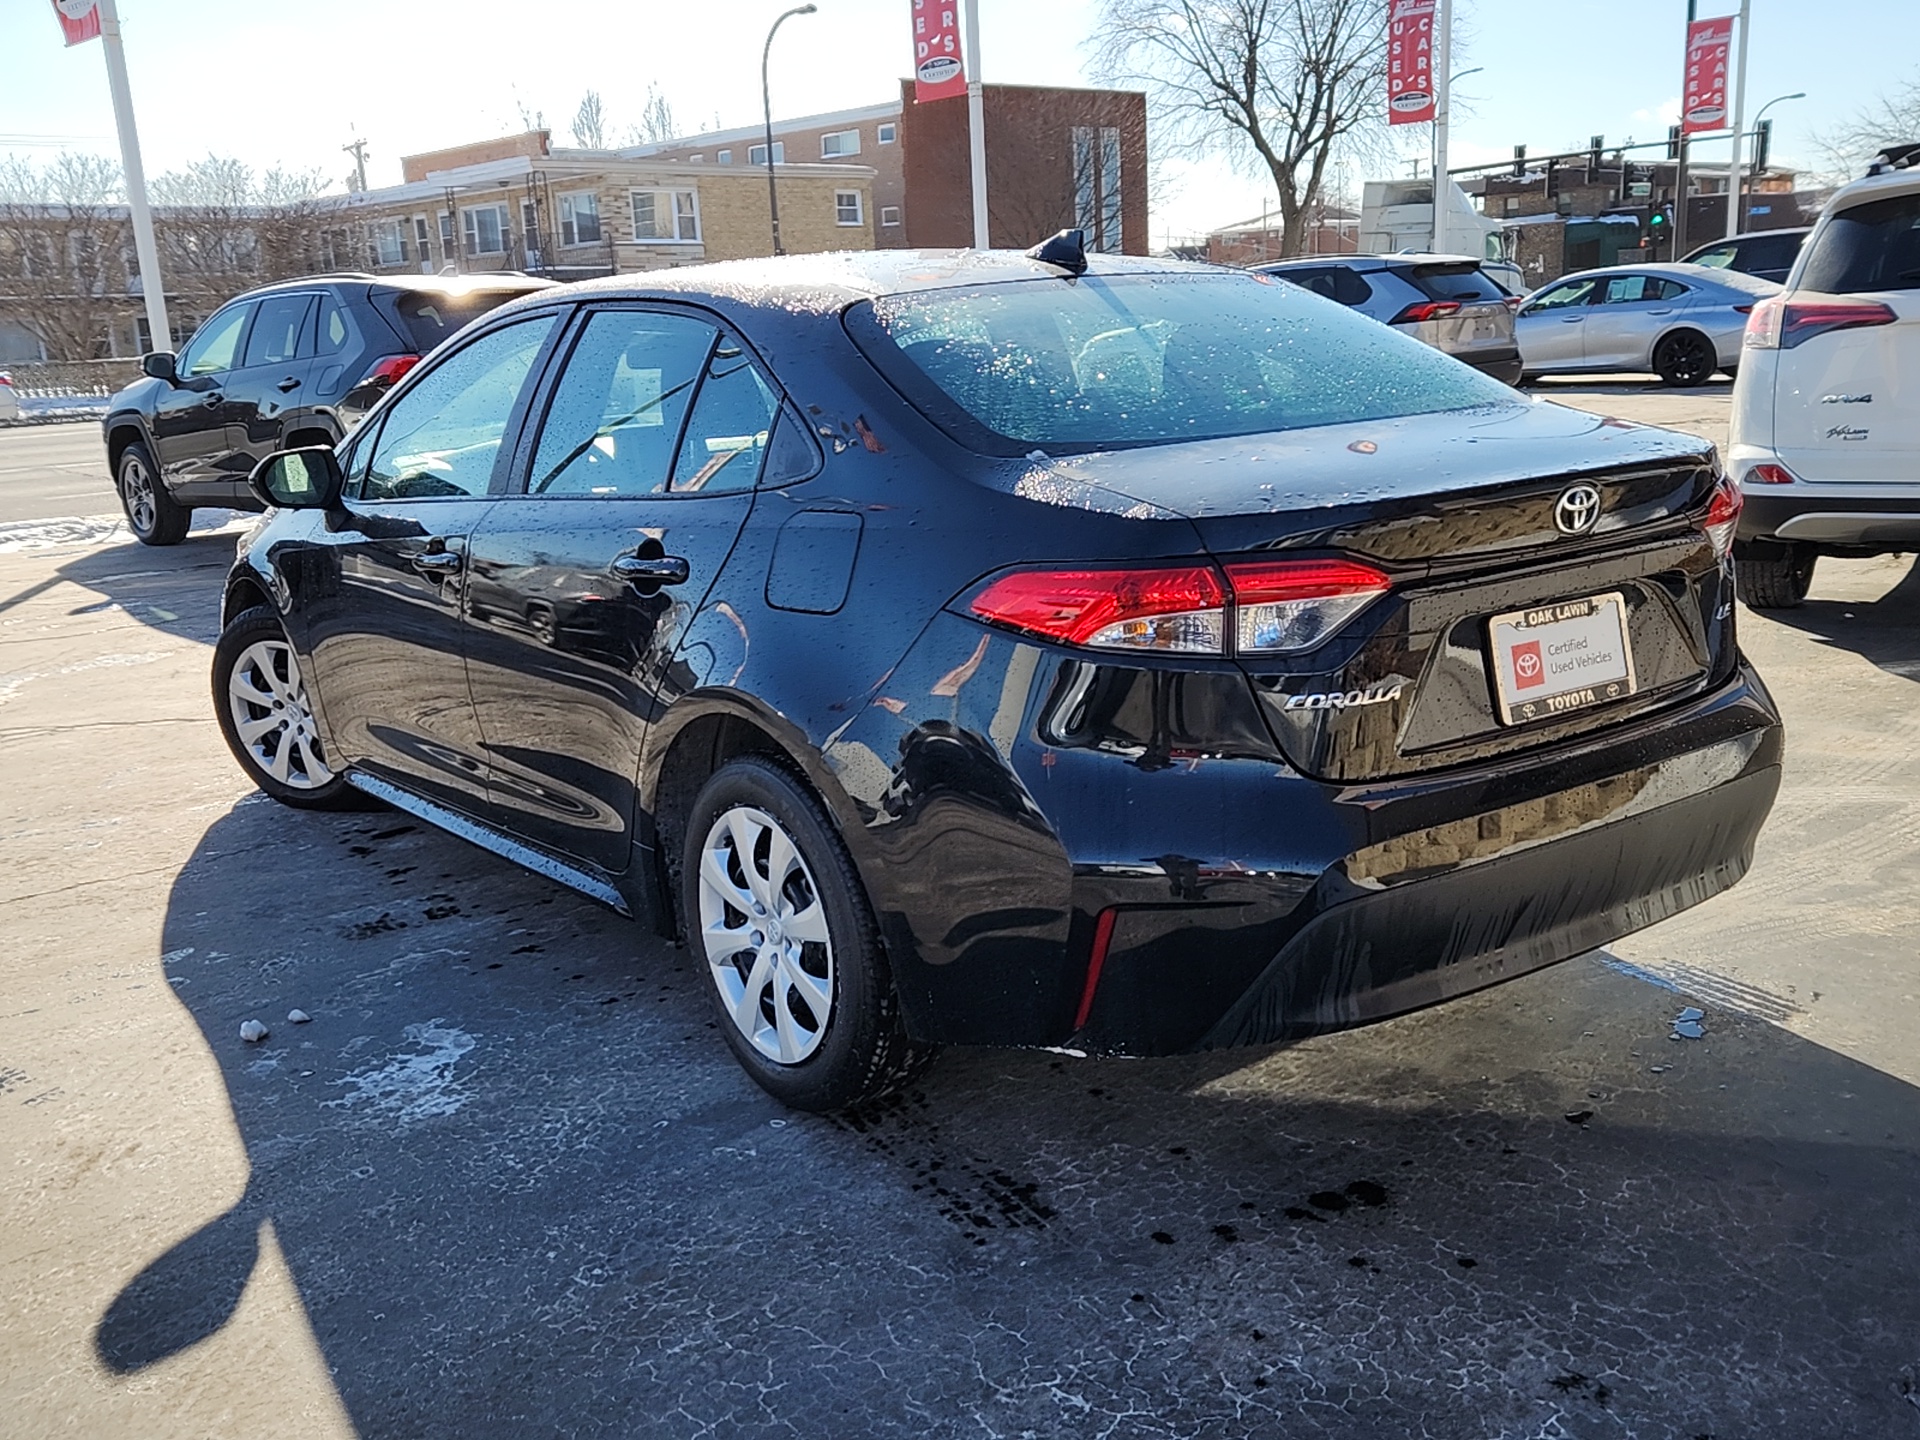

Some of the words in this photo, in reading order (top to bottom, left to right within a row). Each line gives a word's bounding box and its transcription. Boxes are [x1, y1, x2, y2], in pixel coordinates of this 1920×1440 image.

[1392, 21, 1404, 92] USED
[1417, 17, 1430, 89] CARS
[1688, 49, 1702, 107] USED
[1713, 45, 1726, 105] CARS
[1528, 608, 1555, 626] OAK
[1555, 602, 1589, 619] LAWN
[1547, 636, 1588, 656] Certified
[1550, 658, 1574, 675] Used
[1575, 650, 1613, 668] Vehicles
[1283, 684, 1401, 709] COROLLA
[1546, 689, 1596, 711] TOYOTA
